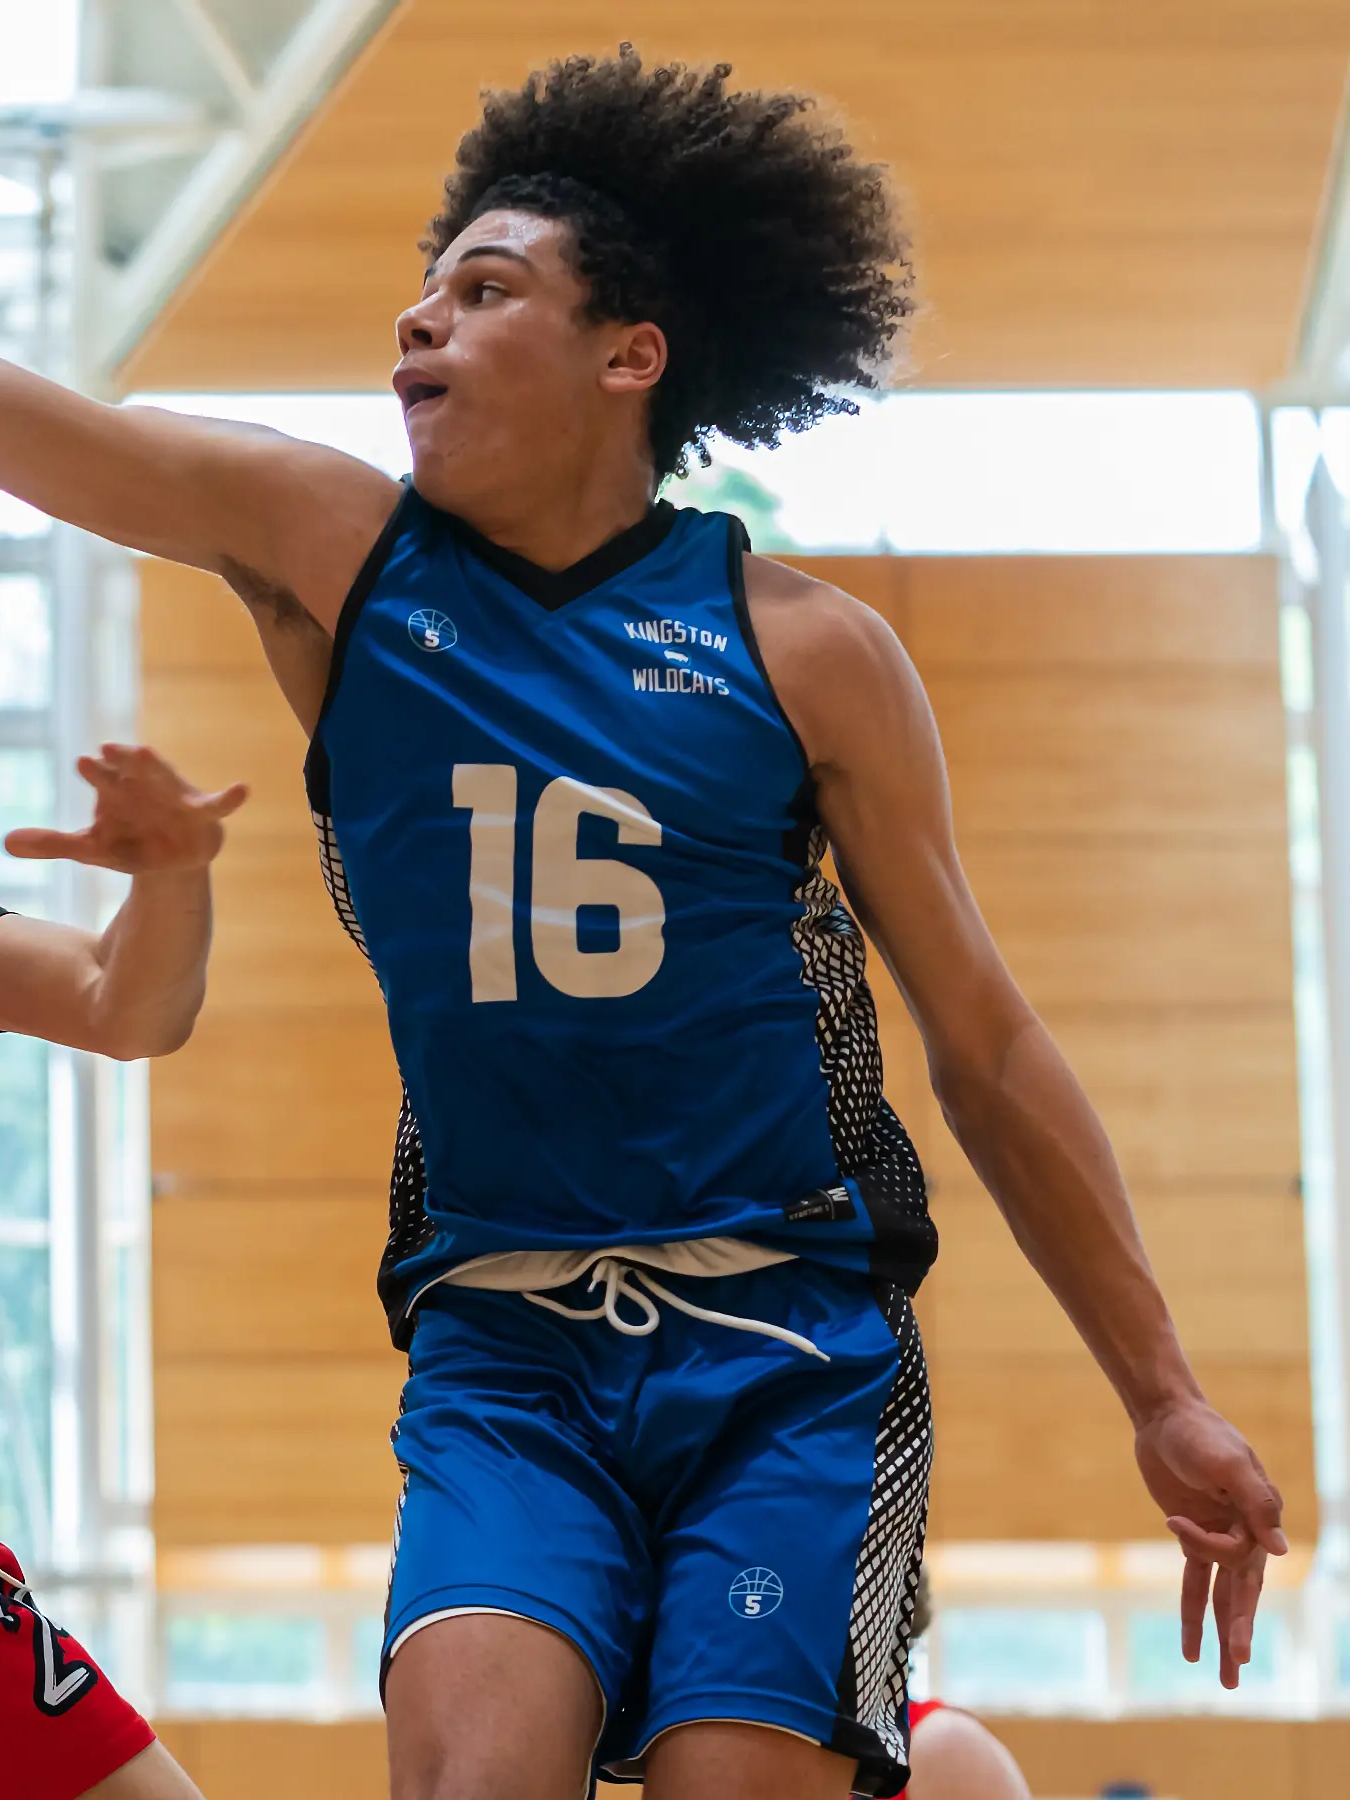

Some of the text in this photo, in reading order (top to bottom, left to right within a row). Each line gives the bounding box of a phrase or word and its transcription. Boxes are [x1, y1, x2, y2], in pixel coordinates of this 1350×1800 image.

[424, 629, 440, 648] 5
[623, 618, 728, 652] KINGSTON
[632, 667, 730, 696] WILDCATS
[452, 763, 666, 1003] 16
[744, 1594, 763, 1615] 5
